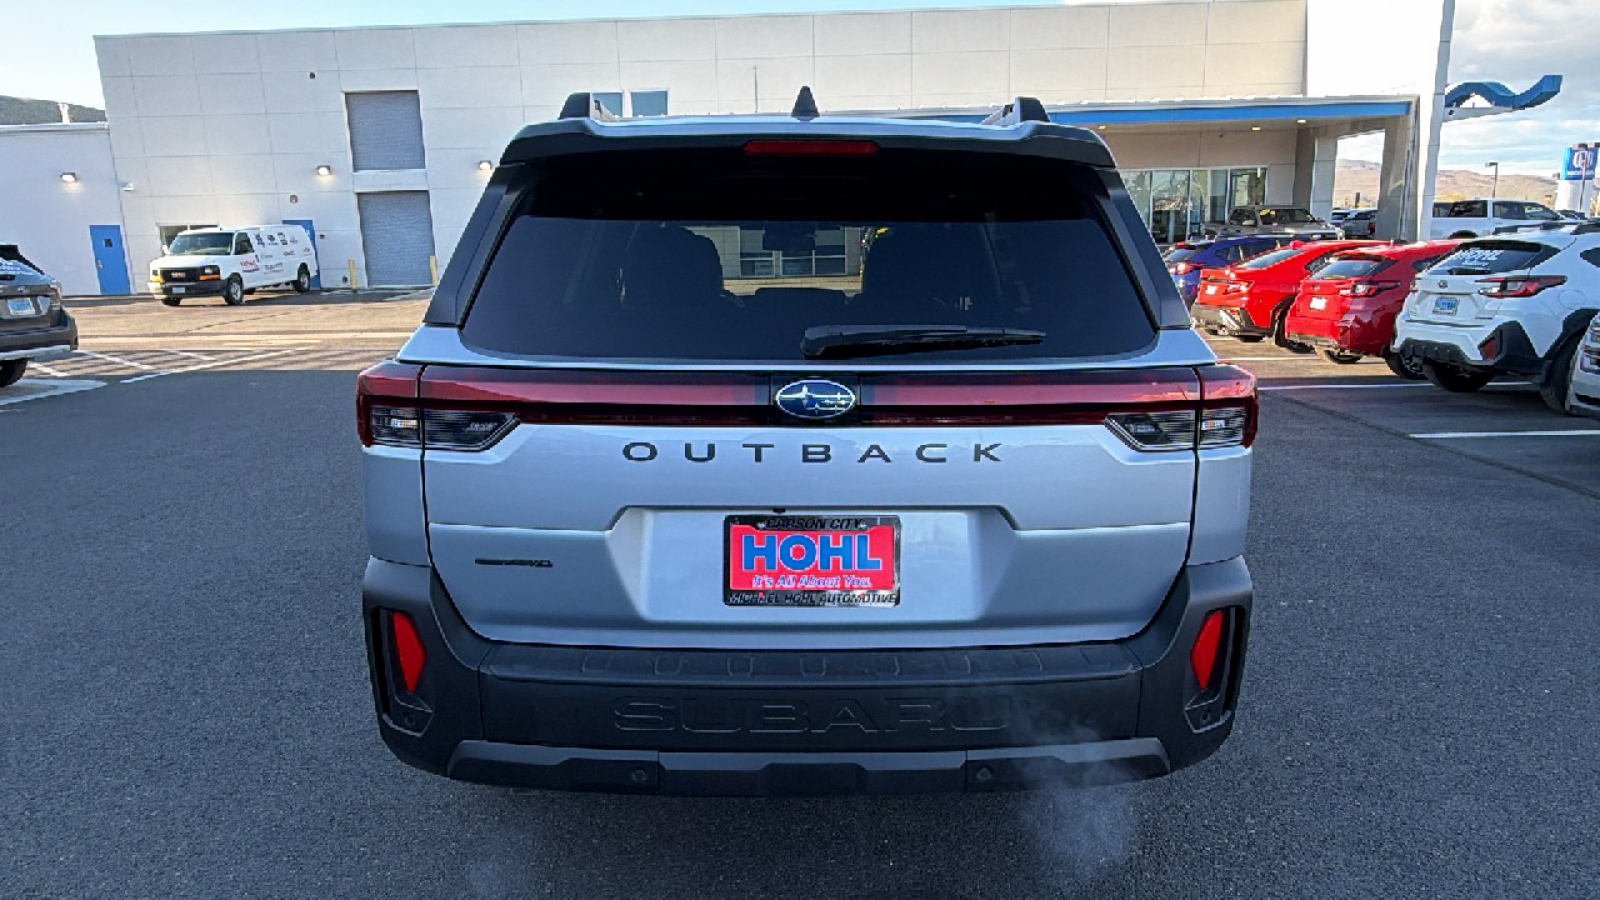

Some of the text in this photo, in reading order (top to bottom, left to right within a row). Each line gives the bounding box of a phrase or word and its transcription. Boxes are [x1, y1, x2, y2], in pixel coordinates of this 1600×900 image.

[622, 441, 1003, 463] OUTBACK
[829, 517, 865, 530] CITY
[742, 534, 882, 571] HOHL
[752, 574, 773, 589] It's
[774, 574, 796, 589] All
[797, 574, 841, 589] About
[613, 696, 1013, 733] SUBARU
